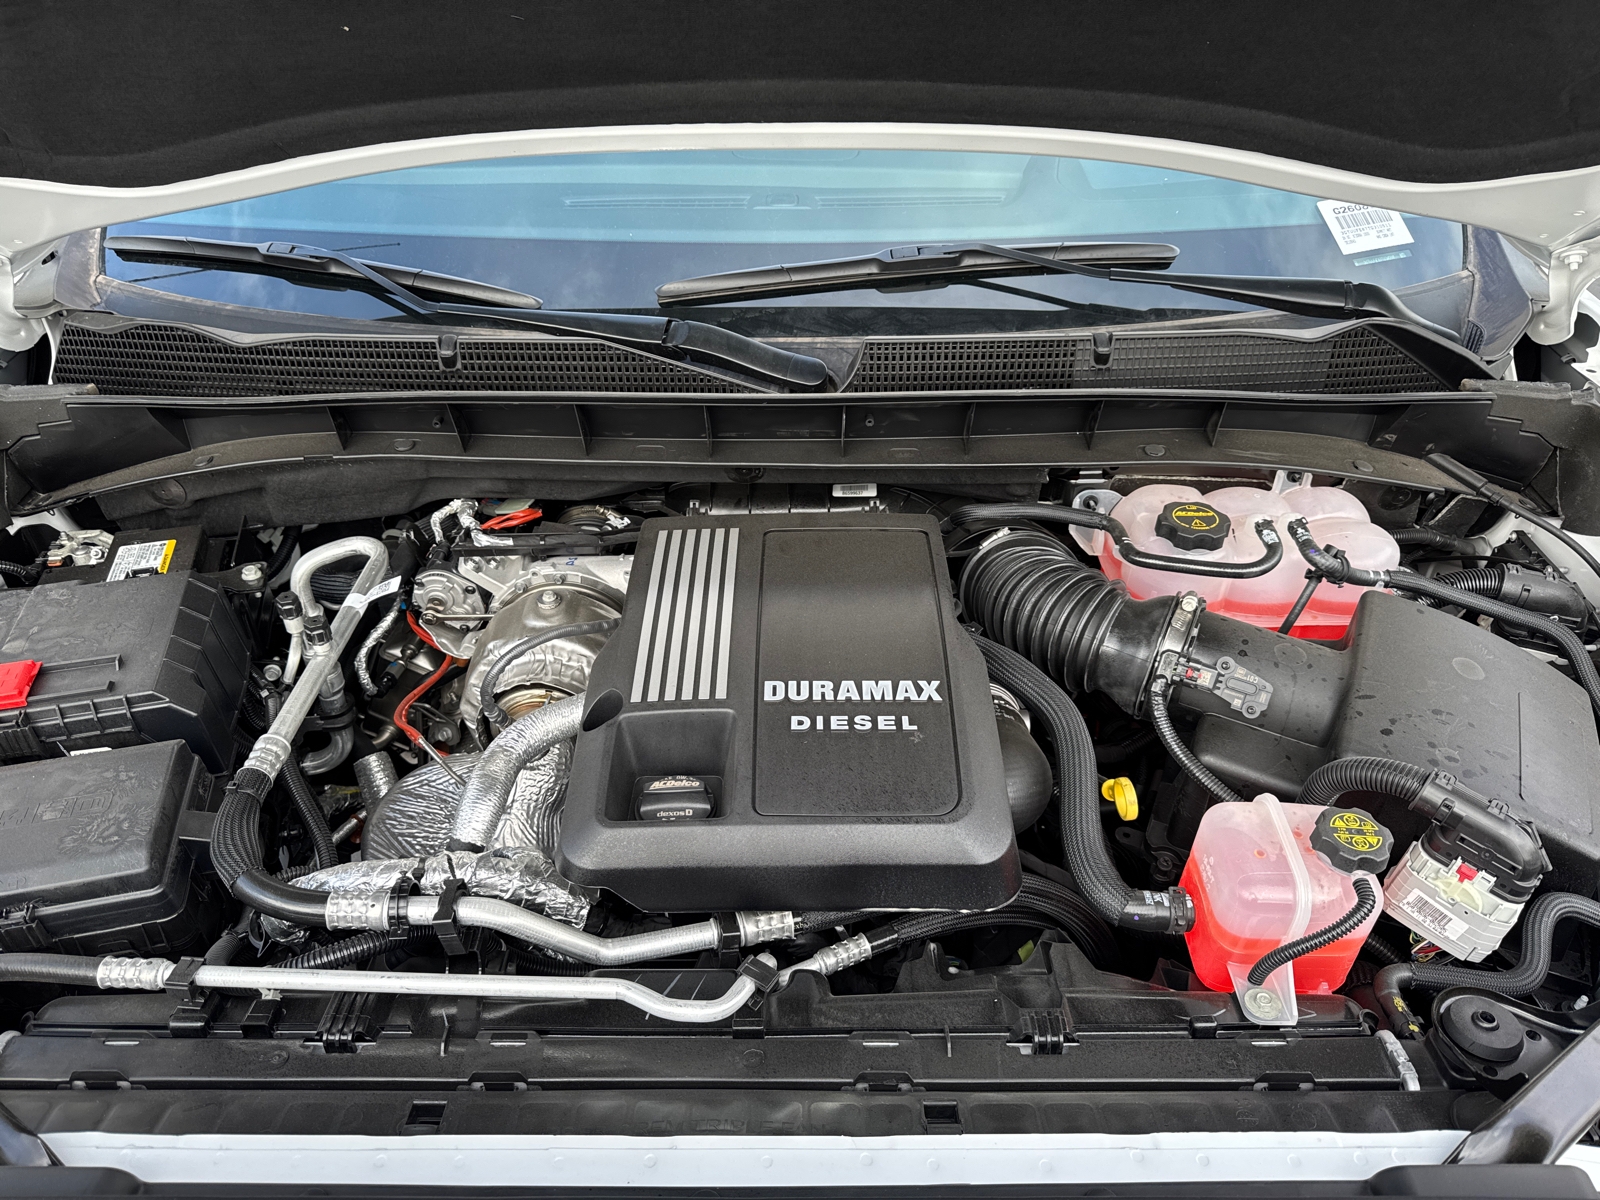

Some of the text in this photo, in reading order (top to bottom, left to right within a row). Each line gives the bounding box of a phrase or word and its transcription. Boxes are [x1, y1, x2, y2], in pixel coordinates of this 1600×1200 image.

[763, 680, 943, 702] DURAMAX
[790, 715, 918, 731] DIESEL
[649, 780, 700, 790] ACDelco
